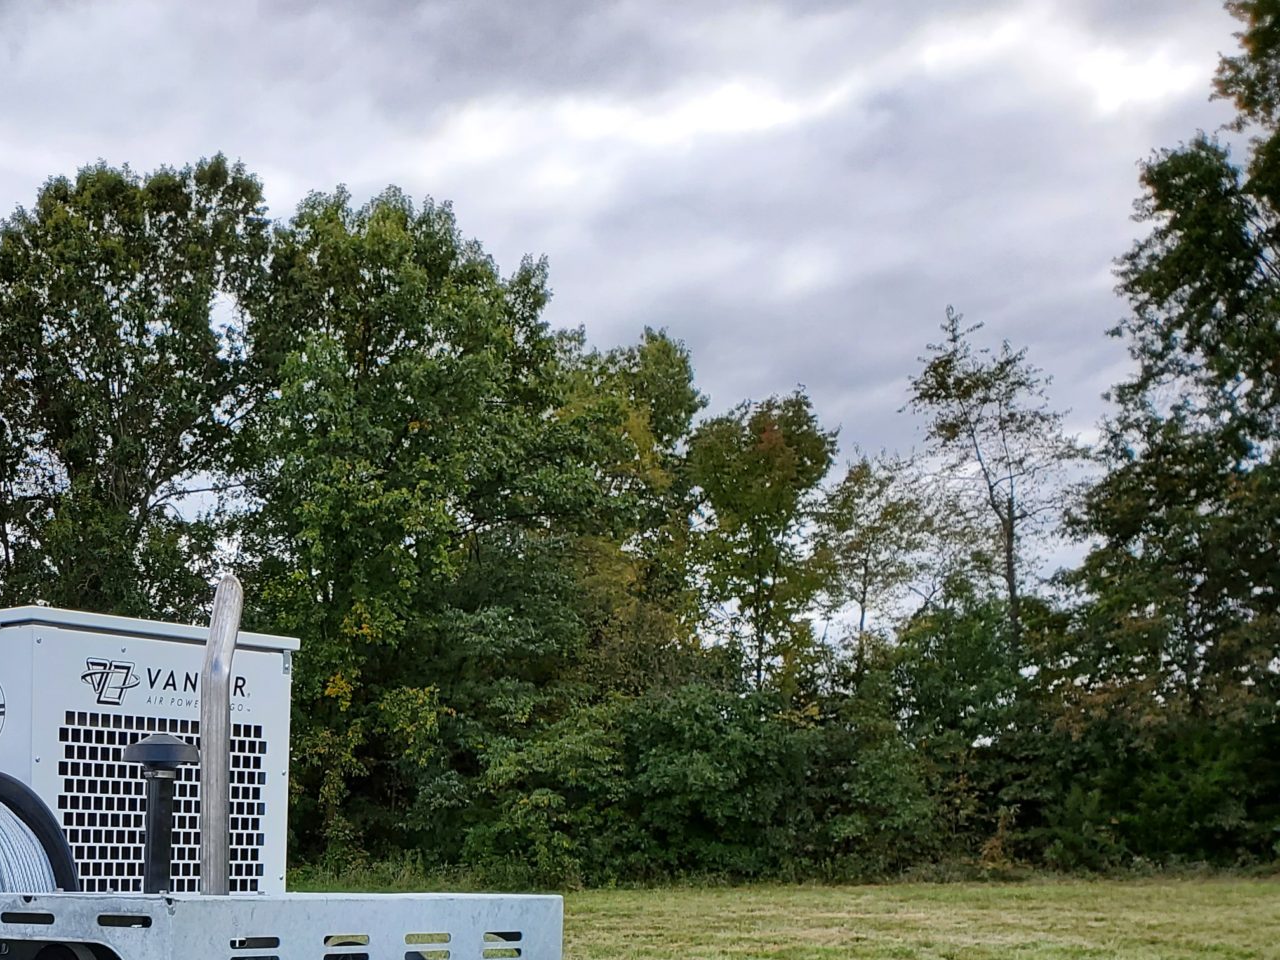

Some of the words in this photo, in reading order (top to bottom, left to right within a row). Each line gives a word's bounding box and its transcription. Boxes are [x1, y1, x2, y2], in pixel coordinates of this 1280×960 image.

[147, 667, 247, 697] VANR
[147, 696, 164, 705] AIR
[170, 698, 199, 709] POWE
